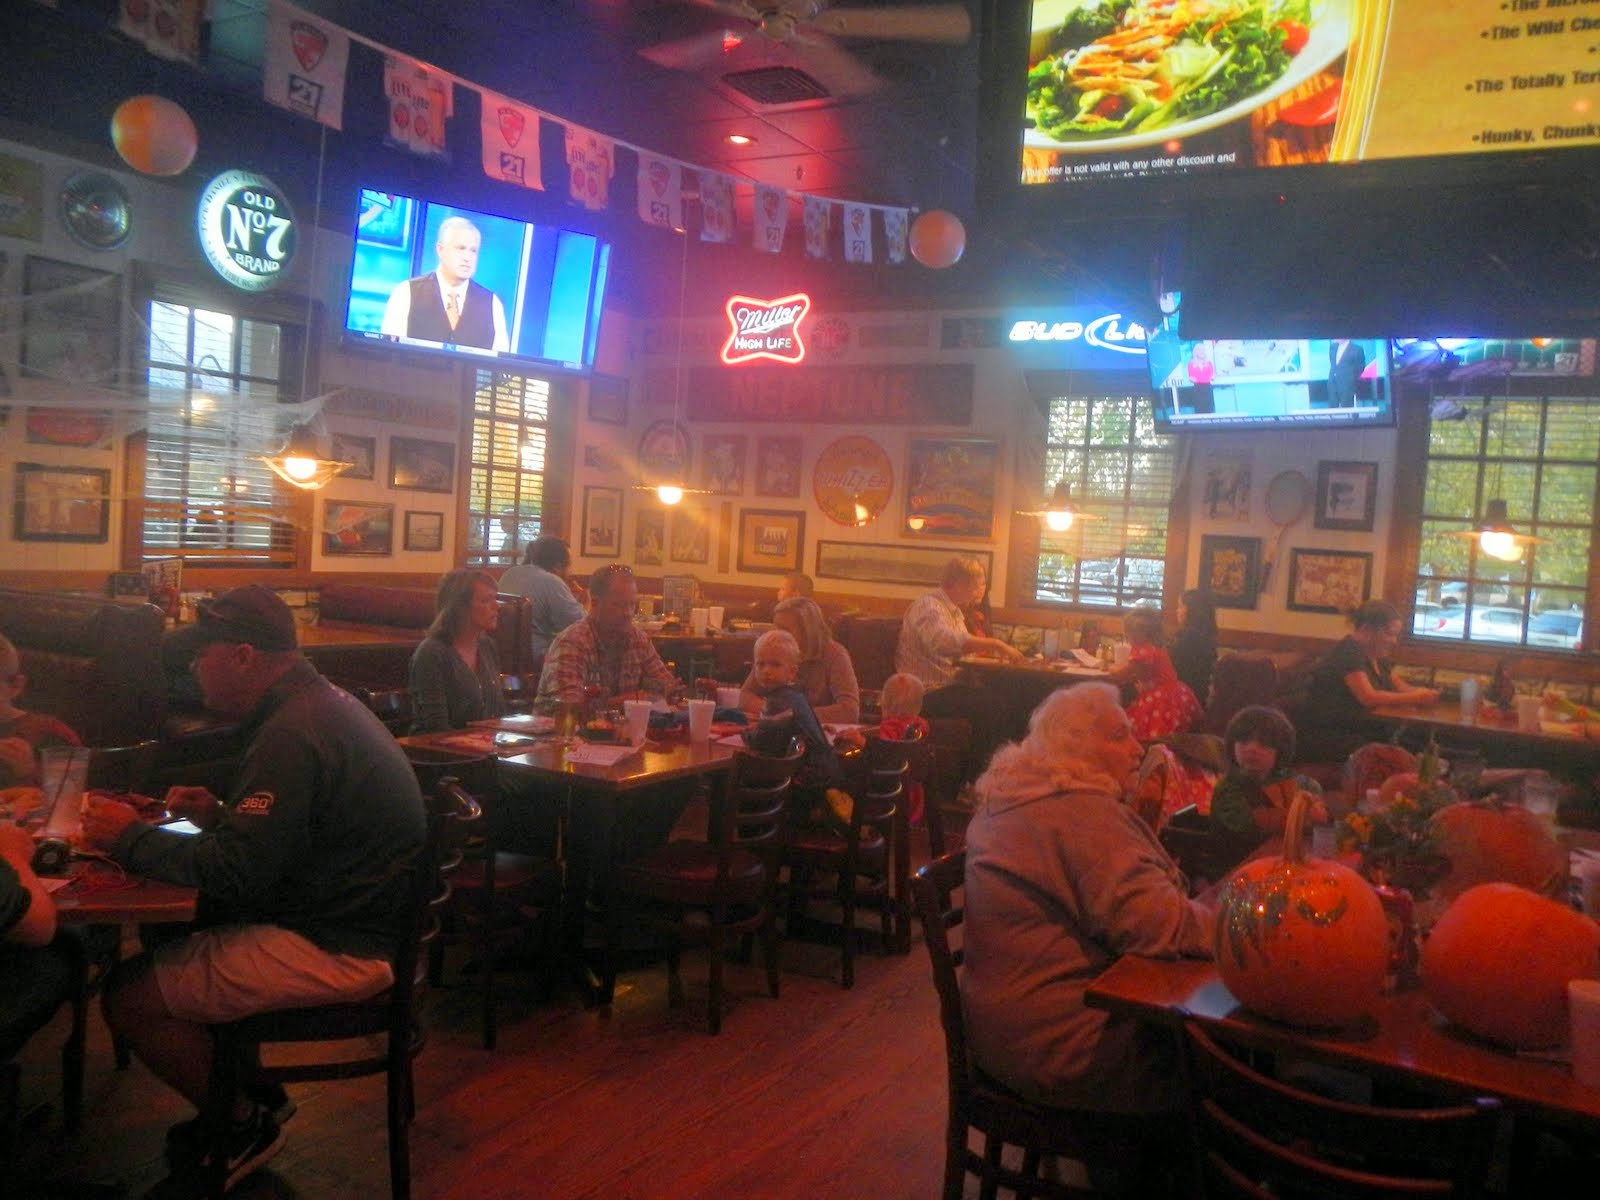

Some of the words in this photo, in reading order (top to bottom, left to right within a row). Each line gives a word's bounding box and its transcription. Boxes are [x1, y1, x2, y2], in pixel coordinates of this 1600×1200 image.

[1492, 25, 1520, 39] The
[1527, 19, 1564, 36] Wild
[1475, 78, 1503, 92] The
[1510, 74, 1564, 89] Totally
[1064, 164, 1072, 174] is
[1073, 163, 1088, 174] not
[1089, 161, 1111, 172] valid
[1112, 159, 1131, 171] with
[1132, 159, 1149, 170] any
[1150, 157, 1175, 169] other
[1176, 153, 1215, 166] discount
[1216, 151, 1236, 164] and
[243, 191, 276, 211] OLD
[234, 252, 280, 273] BRAND
[736, 305, 802, 334] Miller
[1009, 320, 1083, 341] BUD
[734, 337, 763, 350] HIGH
[766, 337, 792, 349] LIFE
[241, 797, 268, 809] 360
